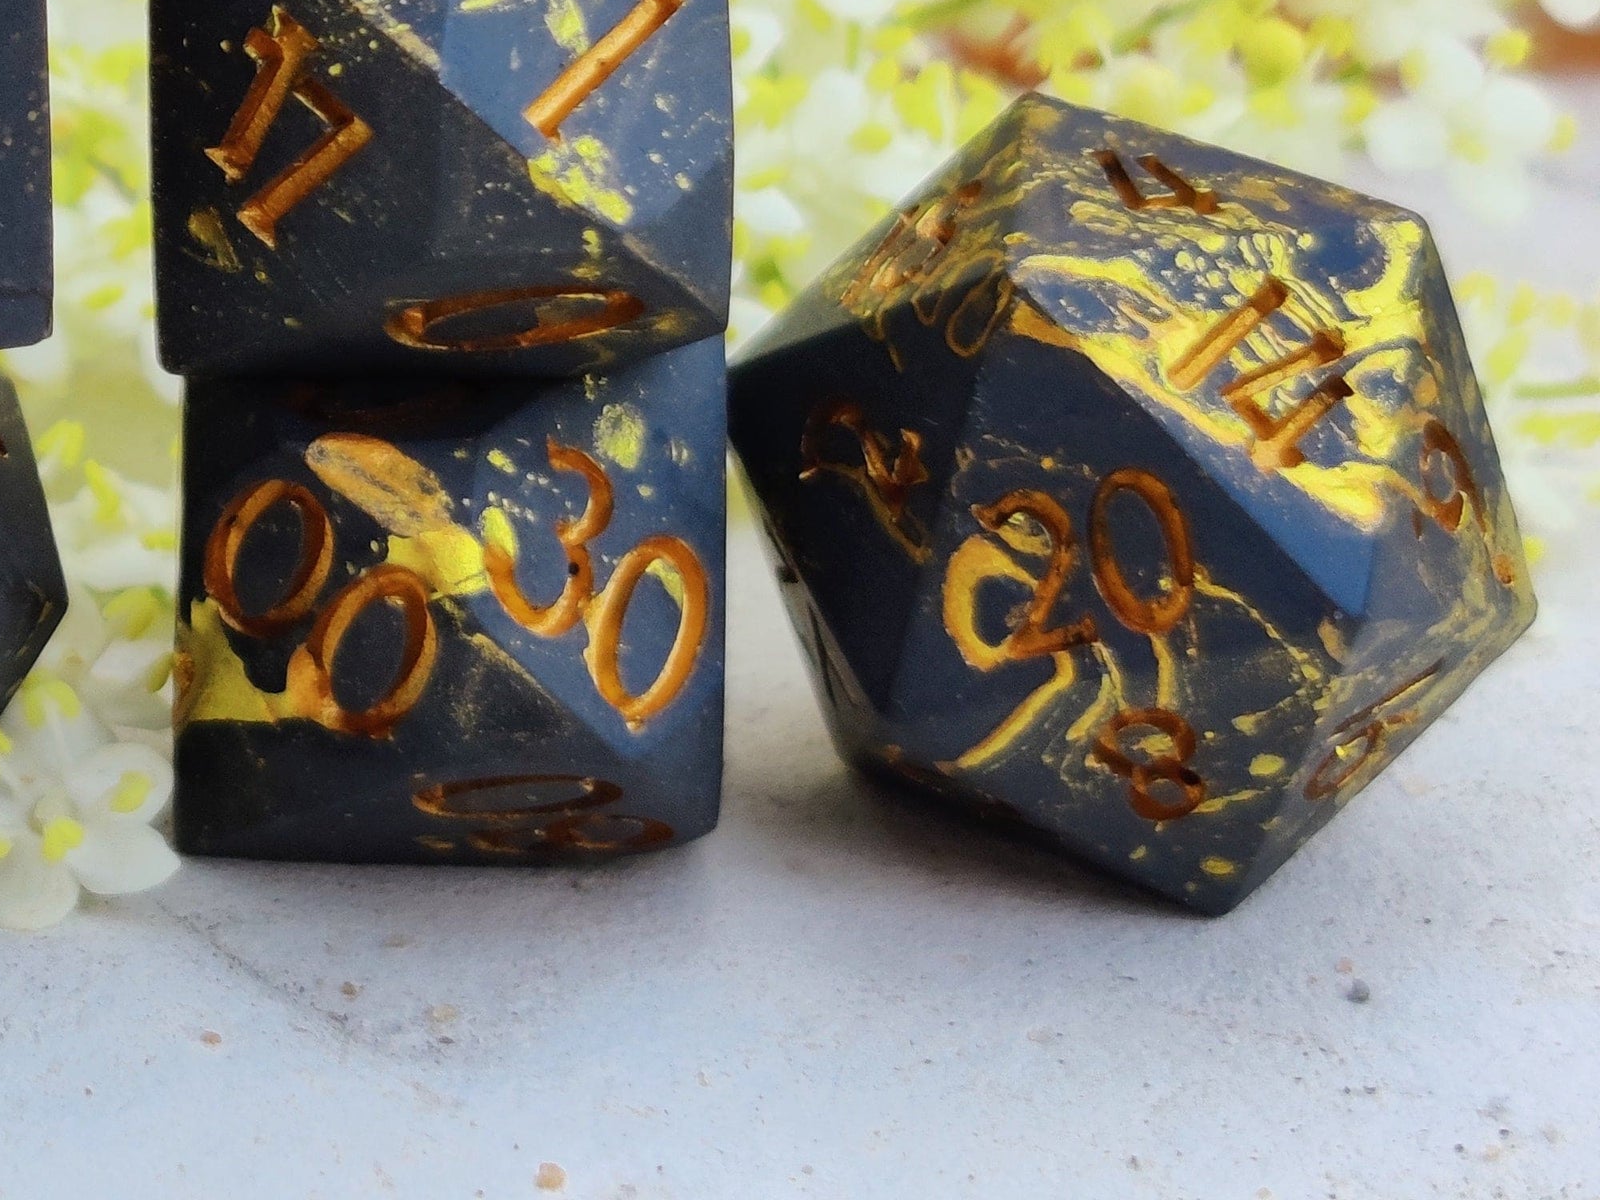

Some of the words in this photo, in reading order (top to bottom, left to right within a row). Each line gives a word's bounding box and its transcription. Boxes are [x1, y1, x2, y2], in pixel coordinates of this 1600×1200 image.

[1166, 276, 1355, 474] 14
[203, 479, 438, 740] 00
[482, 434, 710, 736] 30
[968, 464, 1196, 662] 20
[1094, 706, 1208, 824] 8
